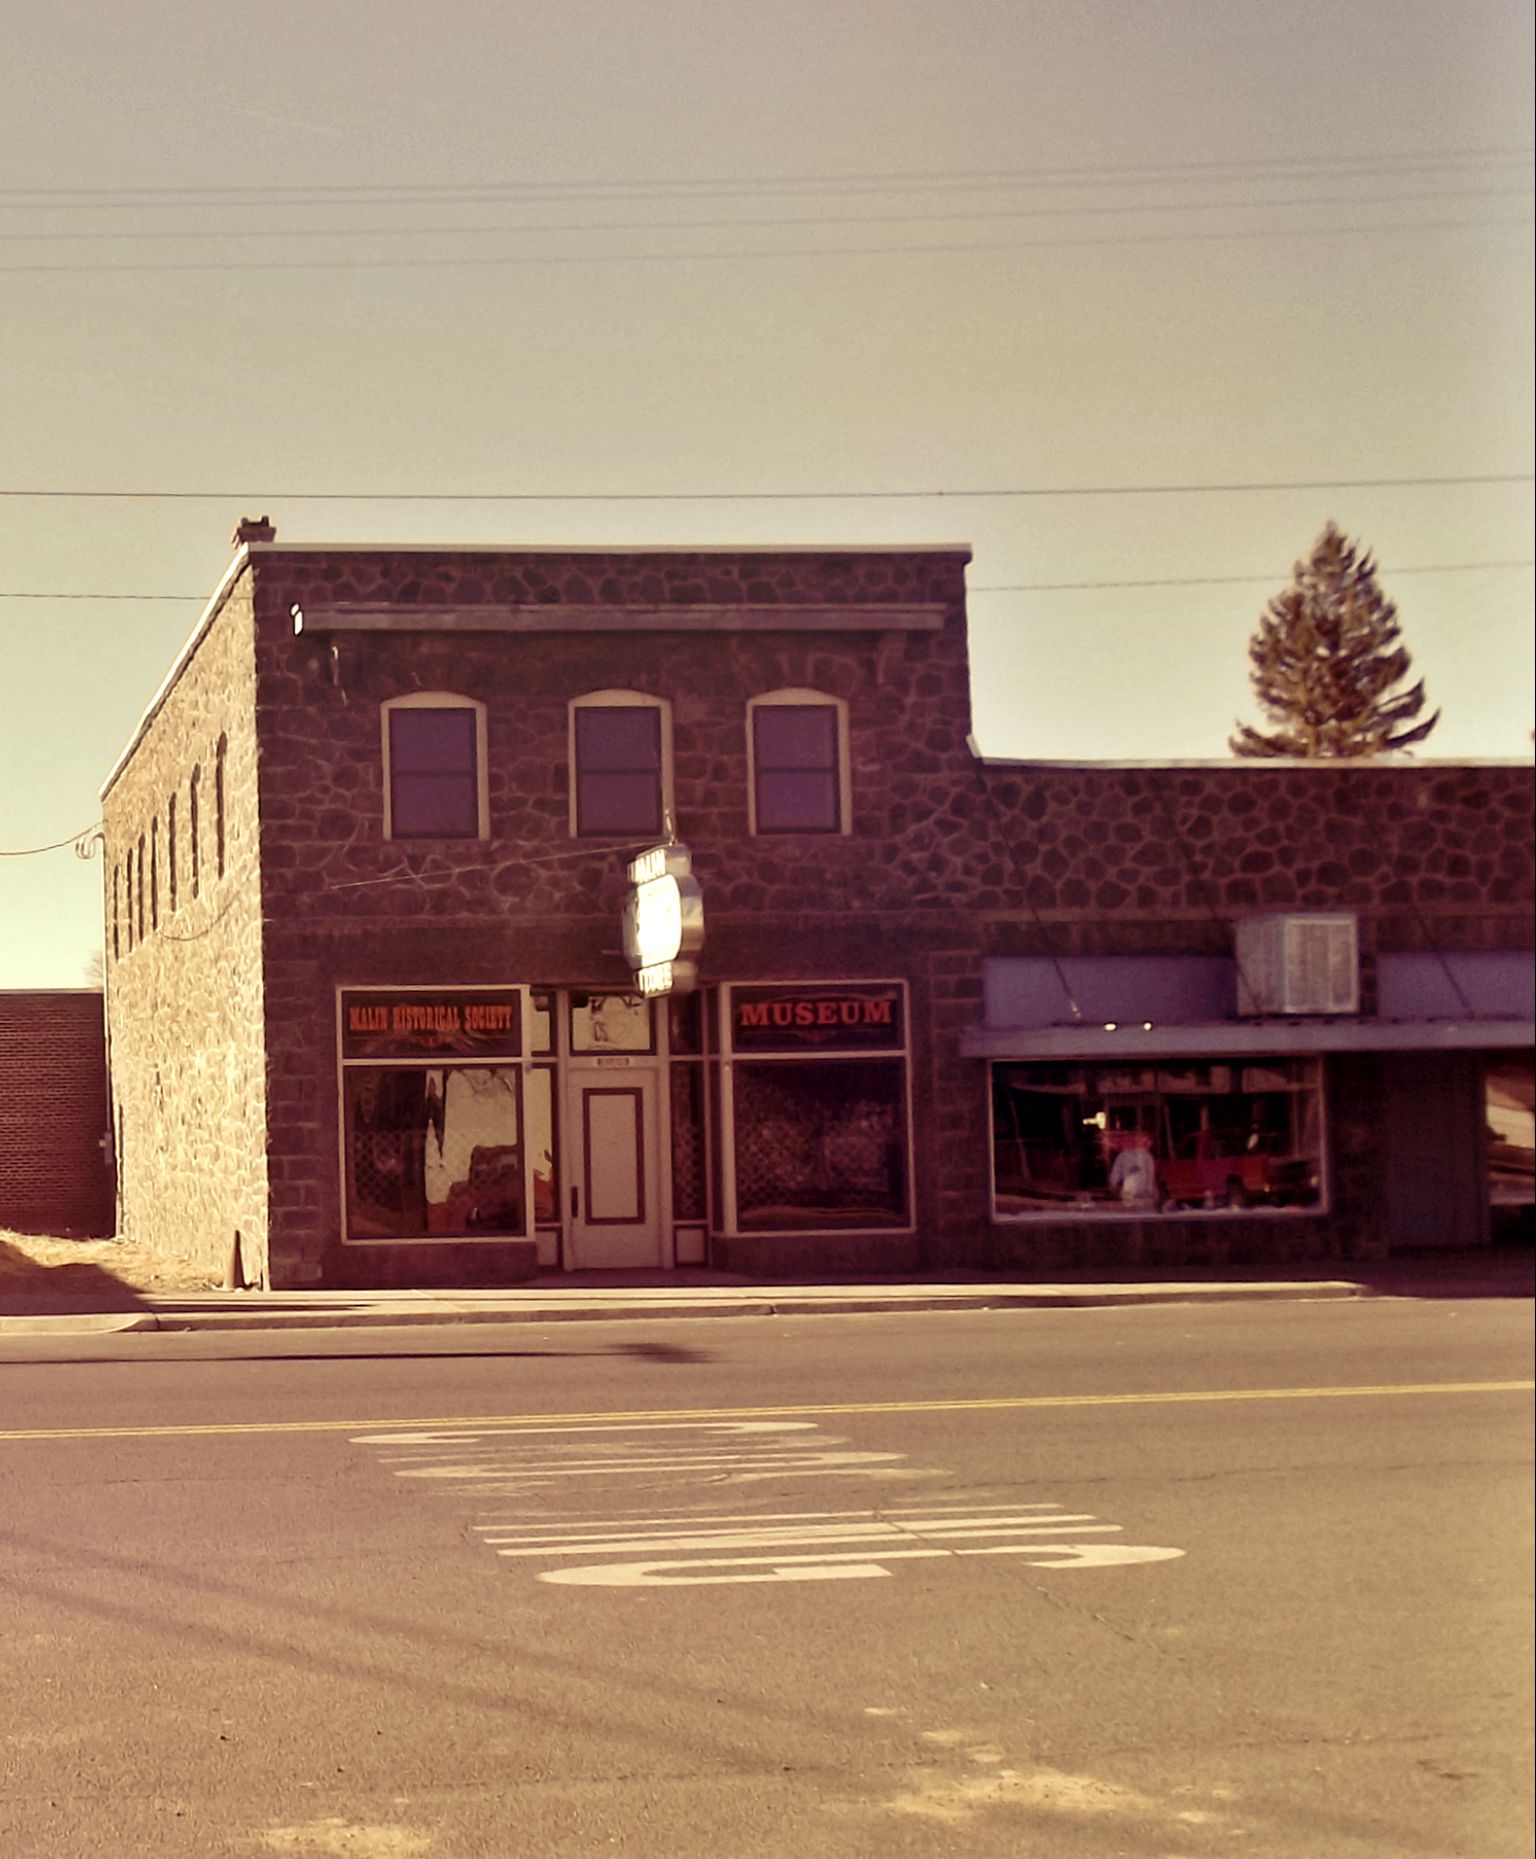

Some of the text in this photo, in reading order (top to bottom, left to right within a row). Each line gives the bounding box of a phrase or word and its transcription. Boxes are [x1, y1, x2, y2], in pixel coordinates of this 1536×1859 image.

[349, 1003, 513, 1031] MALIN HISTORICAL SOCIETY
[739, 1000, 893, 1026] MUSEUM
